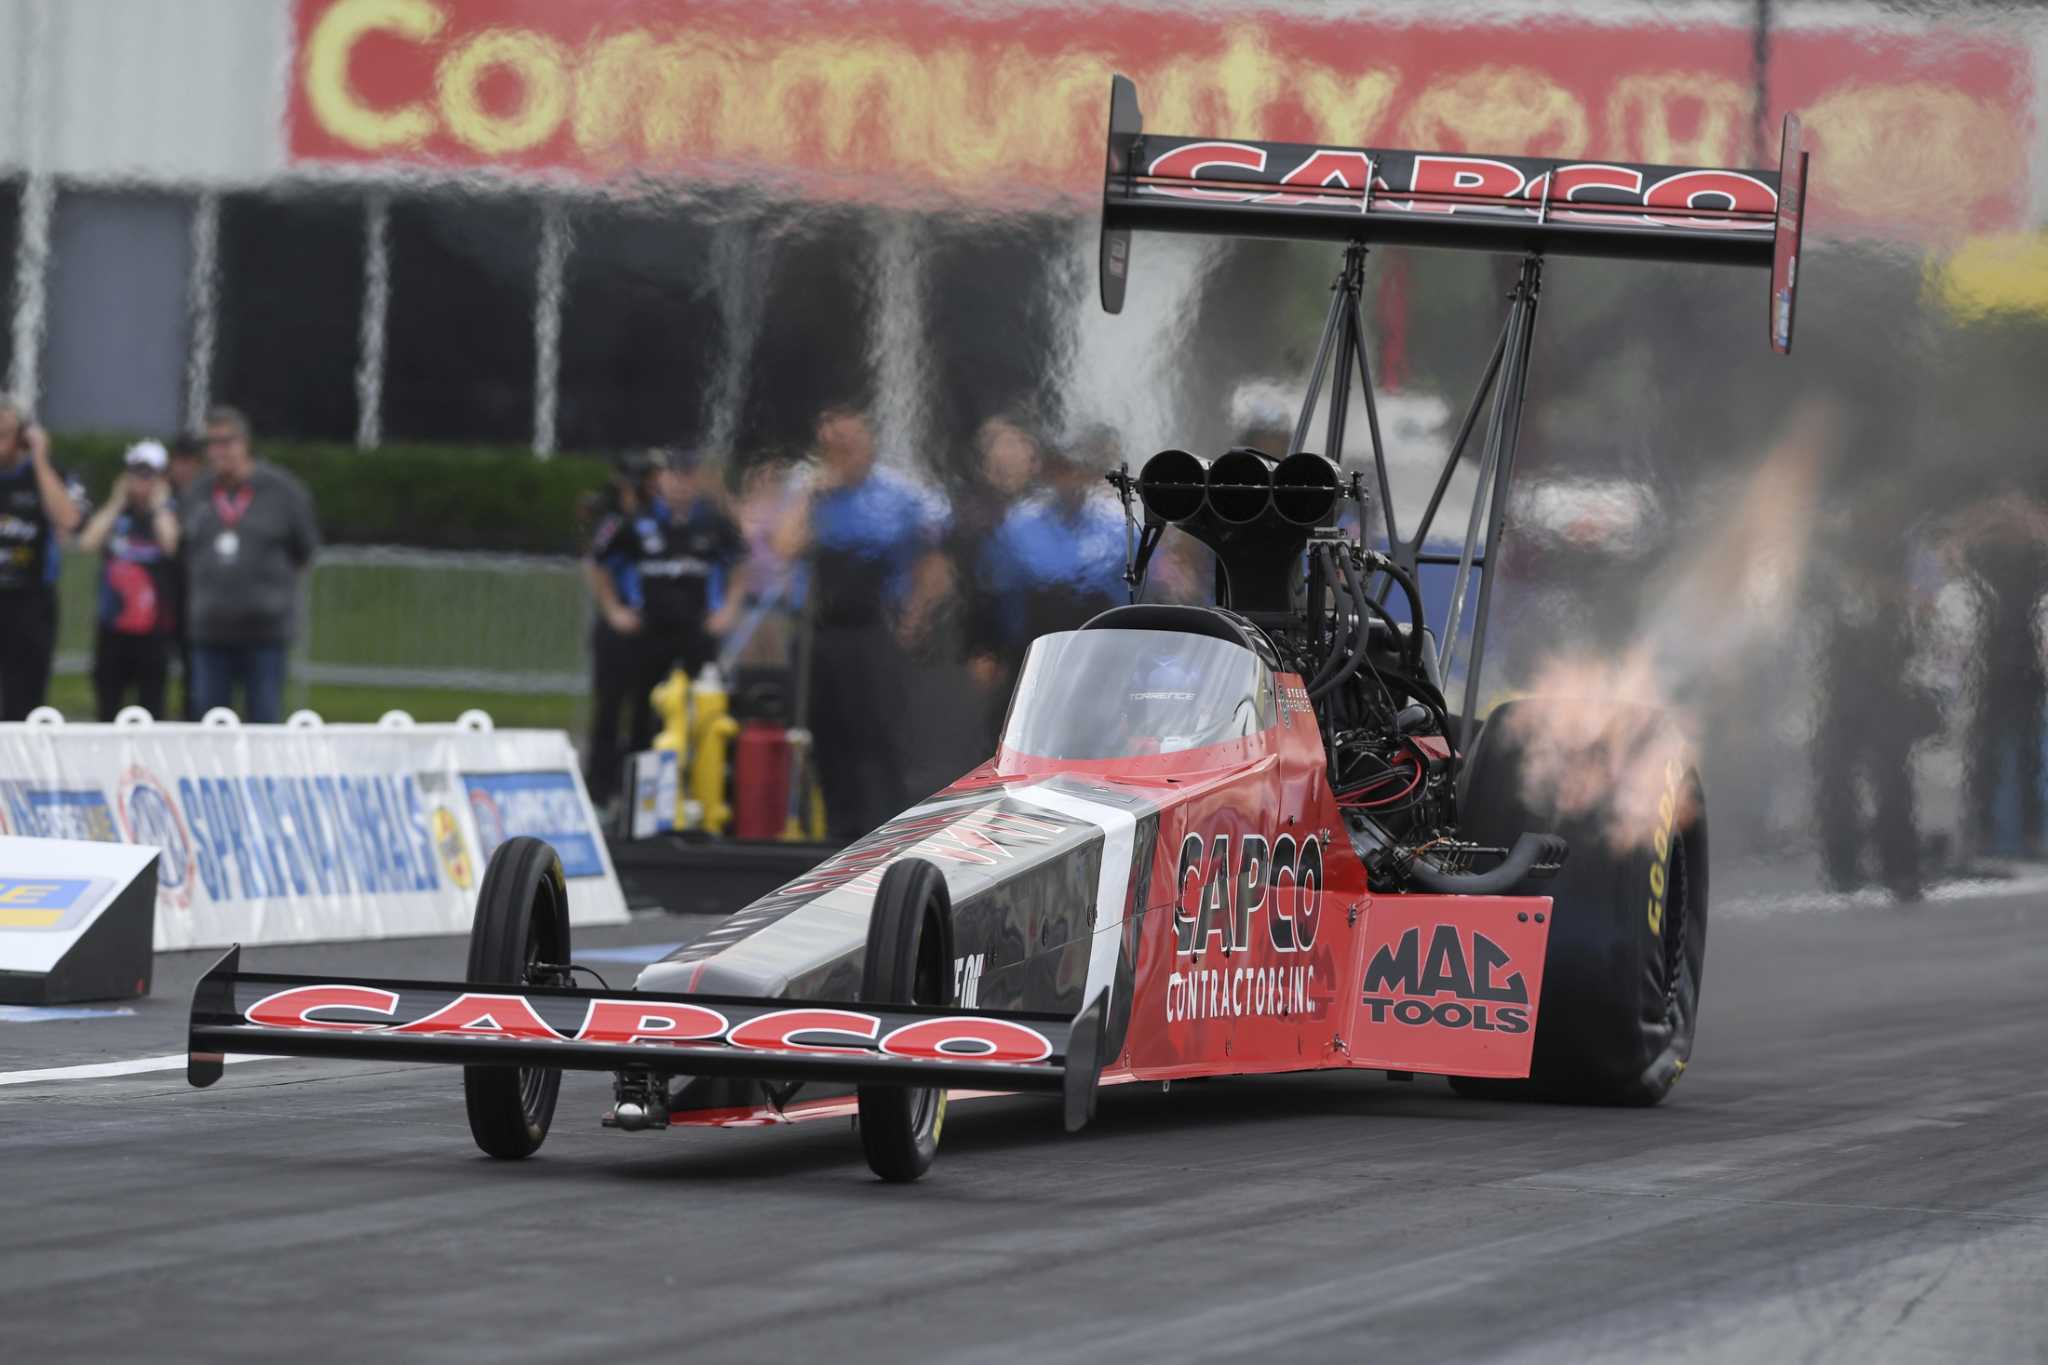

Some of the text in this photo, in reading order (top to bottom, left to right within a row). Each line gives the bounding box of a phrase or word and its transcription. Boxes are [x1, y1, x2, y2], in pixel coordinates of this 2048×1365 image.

[1149, 141, 1779, 229] CAPCO
[1173, 832, 1323, 955] CAPCO
[1362, 923, 1530, 1005] MAC
[244, 984, 1054, 1063] CAPCO
[1362, 997, 1530, 1034] TOOLS
